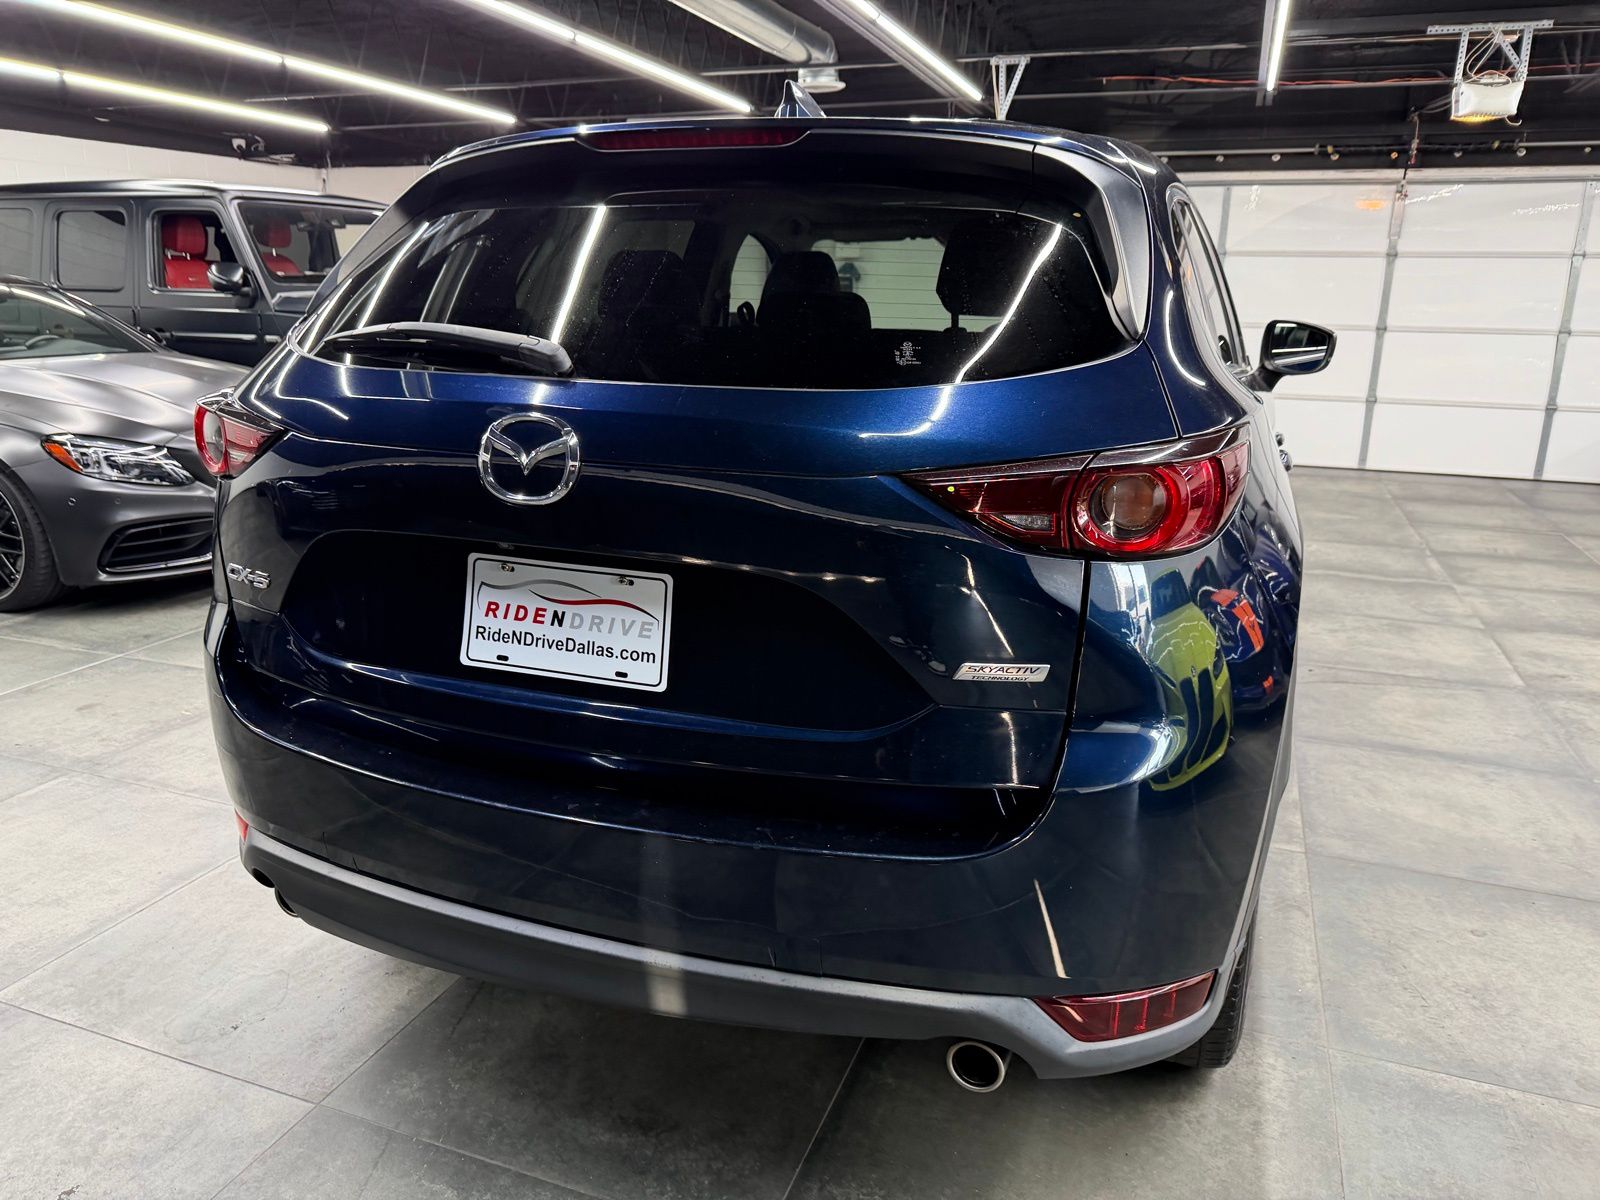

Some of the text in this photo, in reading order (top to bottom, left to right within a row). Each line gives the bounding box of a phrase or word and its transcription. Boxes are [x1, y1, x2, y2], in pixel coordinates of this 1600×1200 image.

[227, 563, 270, 589] CX-5
[484, 601, 654, 639] RIDENDRIVE
[475, 625, 656, 664] RideNDriveDallas.com
[965, 665, 1040, 674] SKYACTIV
